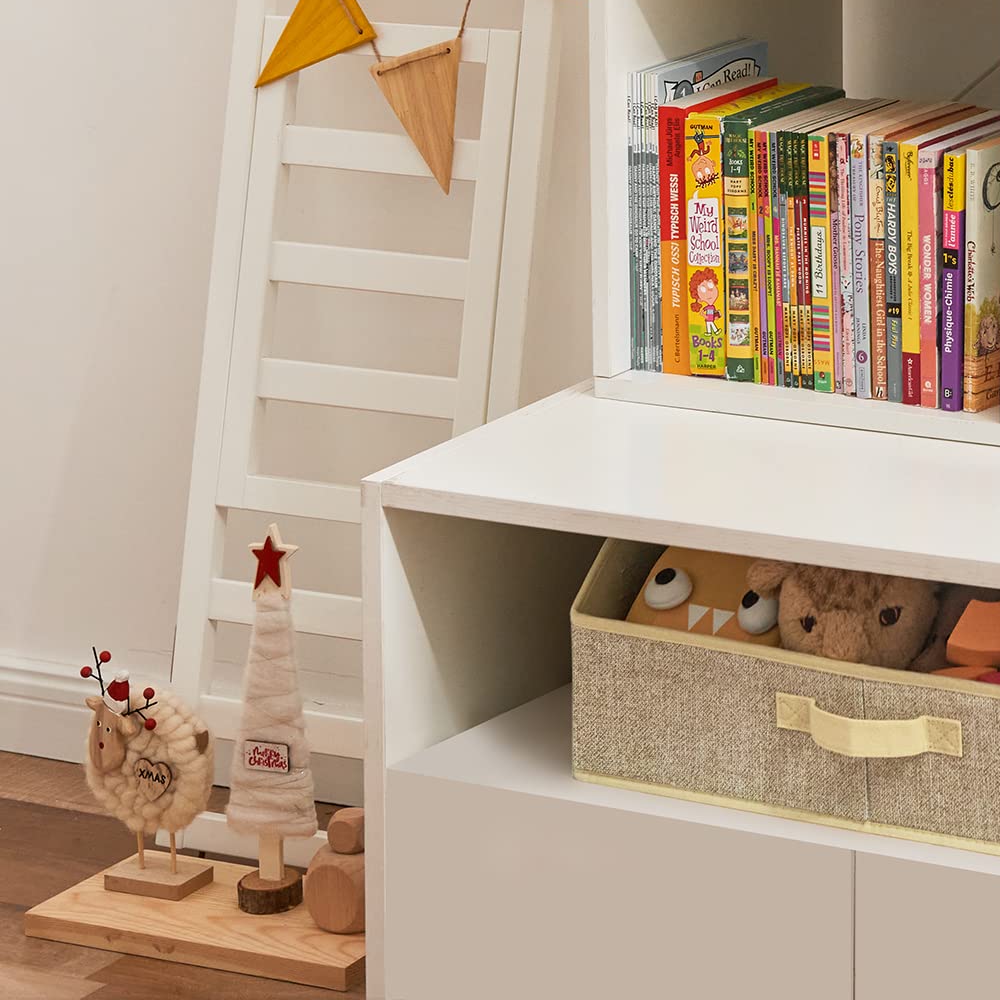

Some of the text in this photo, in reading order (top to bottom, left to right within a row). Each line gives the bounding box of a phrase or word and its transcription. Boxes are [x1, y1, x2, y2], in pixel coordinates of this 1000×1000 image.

[723, 63, 751, 83] Read!
[689, 216, 718, 234] Weird
[694, 202, 714, 217] My
[887, 202, 897, 242] HARDY
[670, 173, 681, 308] TYPISCH OSSI TYPISCH WESSI
[690, 234, 720, 251] School
[948, 214, 956, 248] l'année
[688, 251, 720, 264] Collection
[815, 230, 825, 294] 11 Birthdays
[854, 214, 866, 293] Pony Stories
[888, 244, 898, 275] BOYS
[923, 234, 932, 324] WONDER WOMEN
[967, 240, 976, 302] Charlotte's Web
[874, 242, 886, 385] The Naughtiest Girl in the School
[944, 272, 954, 353] Physique-Chimie
[691, 335, 723, 349] Books
[698, 350, 715, 362] 1-4
[138, 768, 167, 785] XMAS
